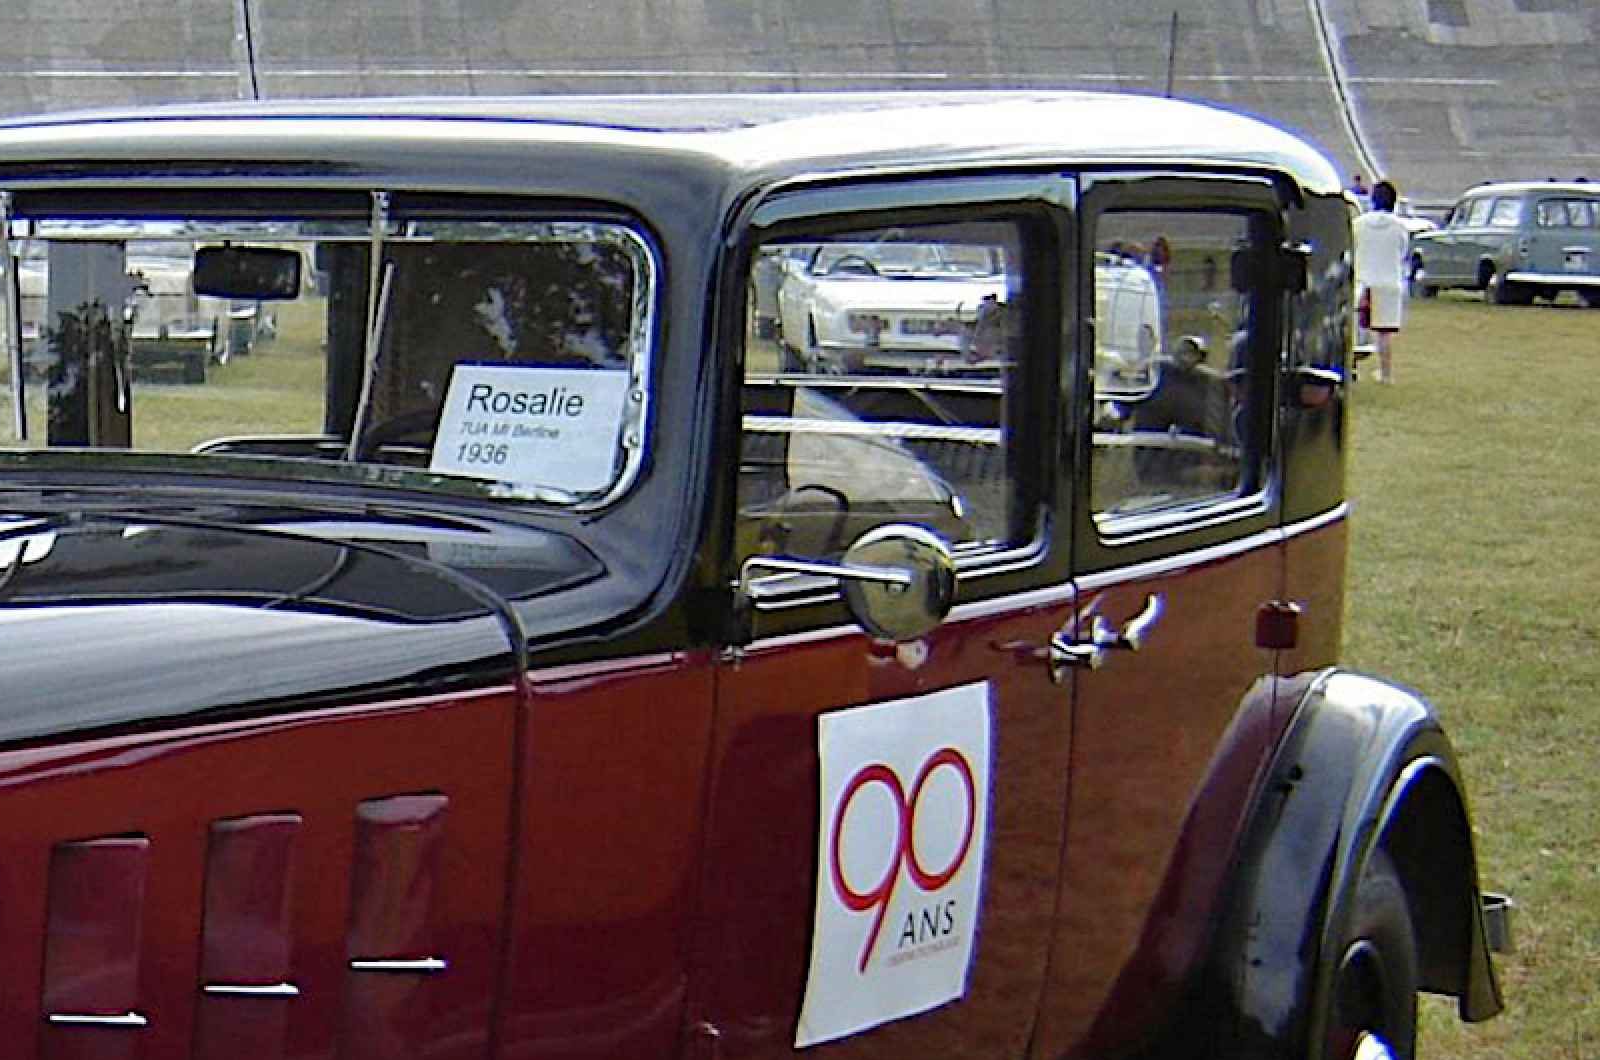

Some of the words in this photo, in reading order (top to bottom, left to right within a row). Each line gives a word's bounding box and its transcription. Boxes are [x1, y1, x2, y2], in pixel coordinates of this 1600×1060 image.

[467, 385, 584, 416] Rosalie
[457, 442, 509, 464] 1936
[831, 748, 975, 973] 90
[898, 900, 956, 948] ANS
